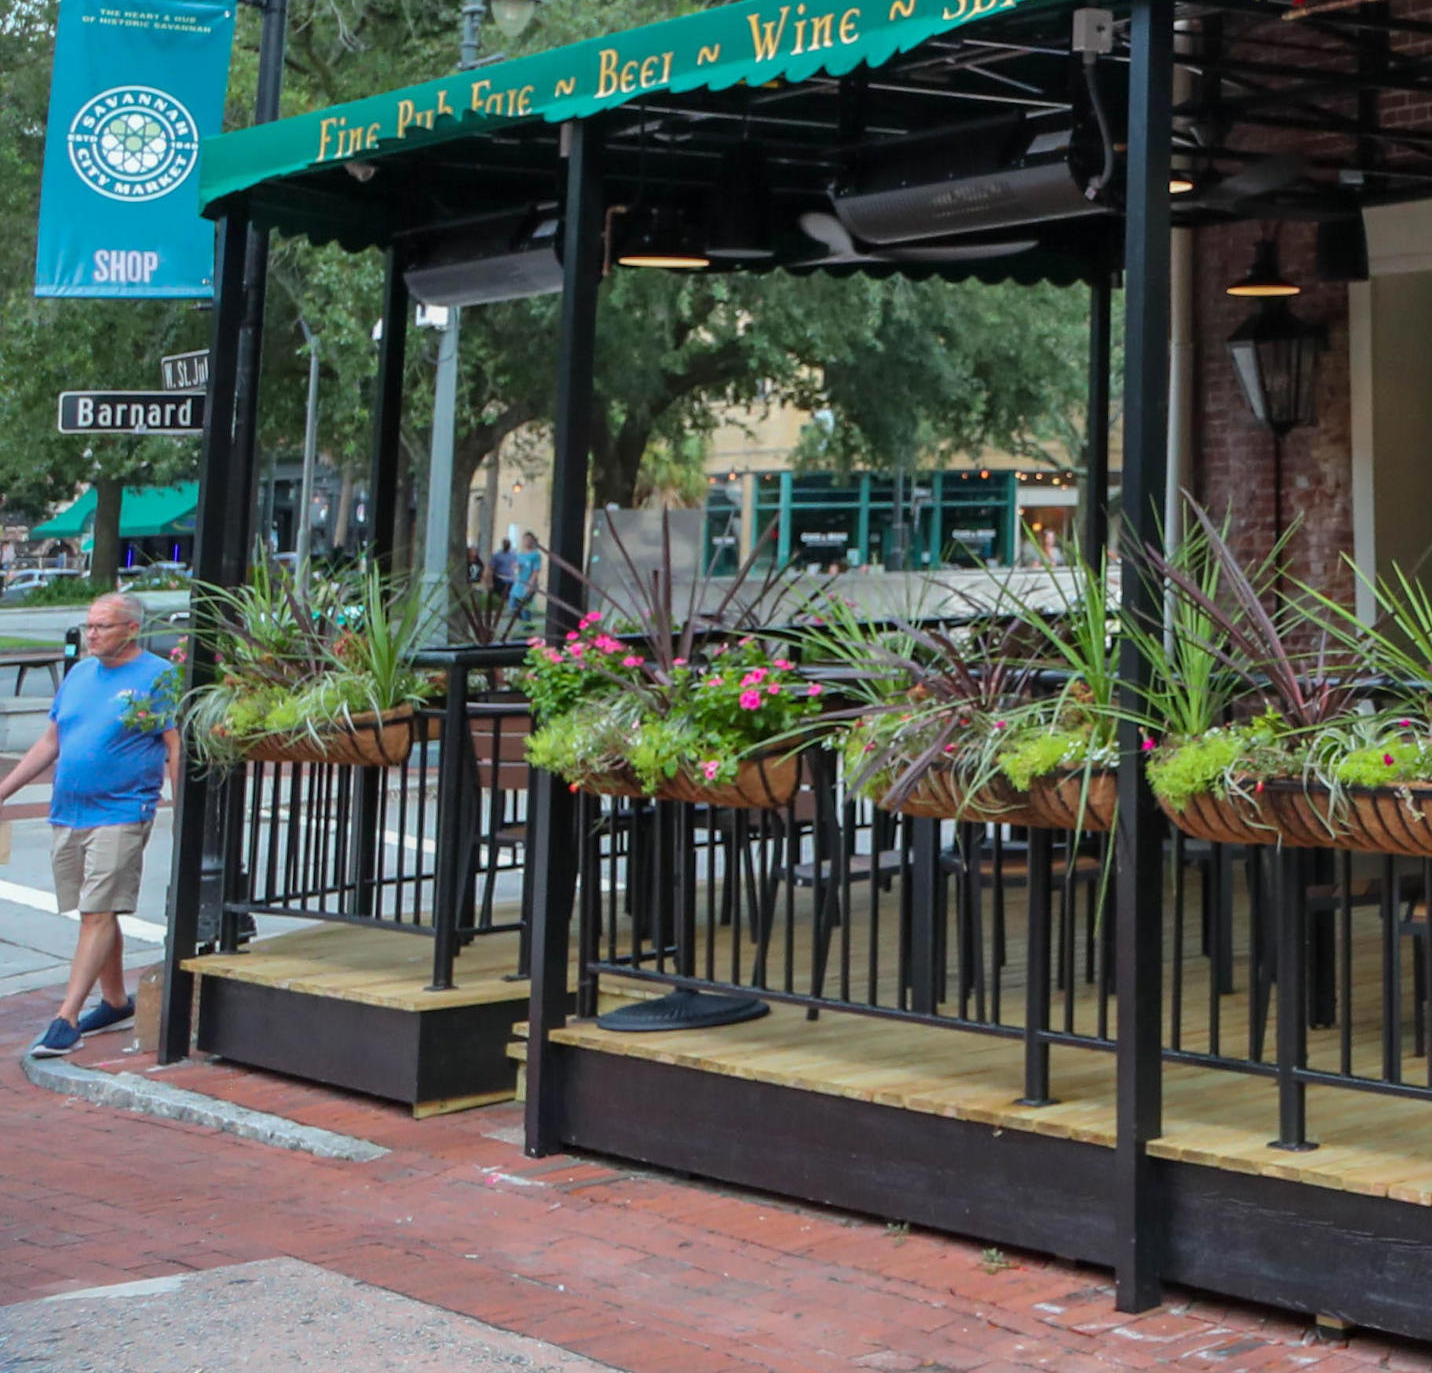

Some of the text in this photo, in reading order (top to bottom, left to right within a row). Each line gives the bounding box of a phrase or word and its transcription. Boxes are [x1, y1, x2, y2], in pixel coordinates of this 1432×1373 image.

[81, 15, 212, 34] OF HISTORIC SAVANNAH
[99, 8, 121, 17] THE
[124, 11, 159, 20] HEART
[315, 116, 381, 162] Fine
[594, 48, 674, 99] Beer
[746, 3, 861, 63] Wine
[82, 93, 188, 135] SAVANNAH
[77, 148, 187, 195] CITY MARKET
[94, 249, 158, 283] SHOP
[164, 362, 176, 389] W.
[177, 360, 191, 388] St.
[77, 397, 193, 428] Barnard
